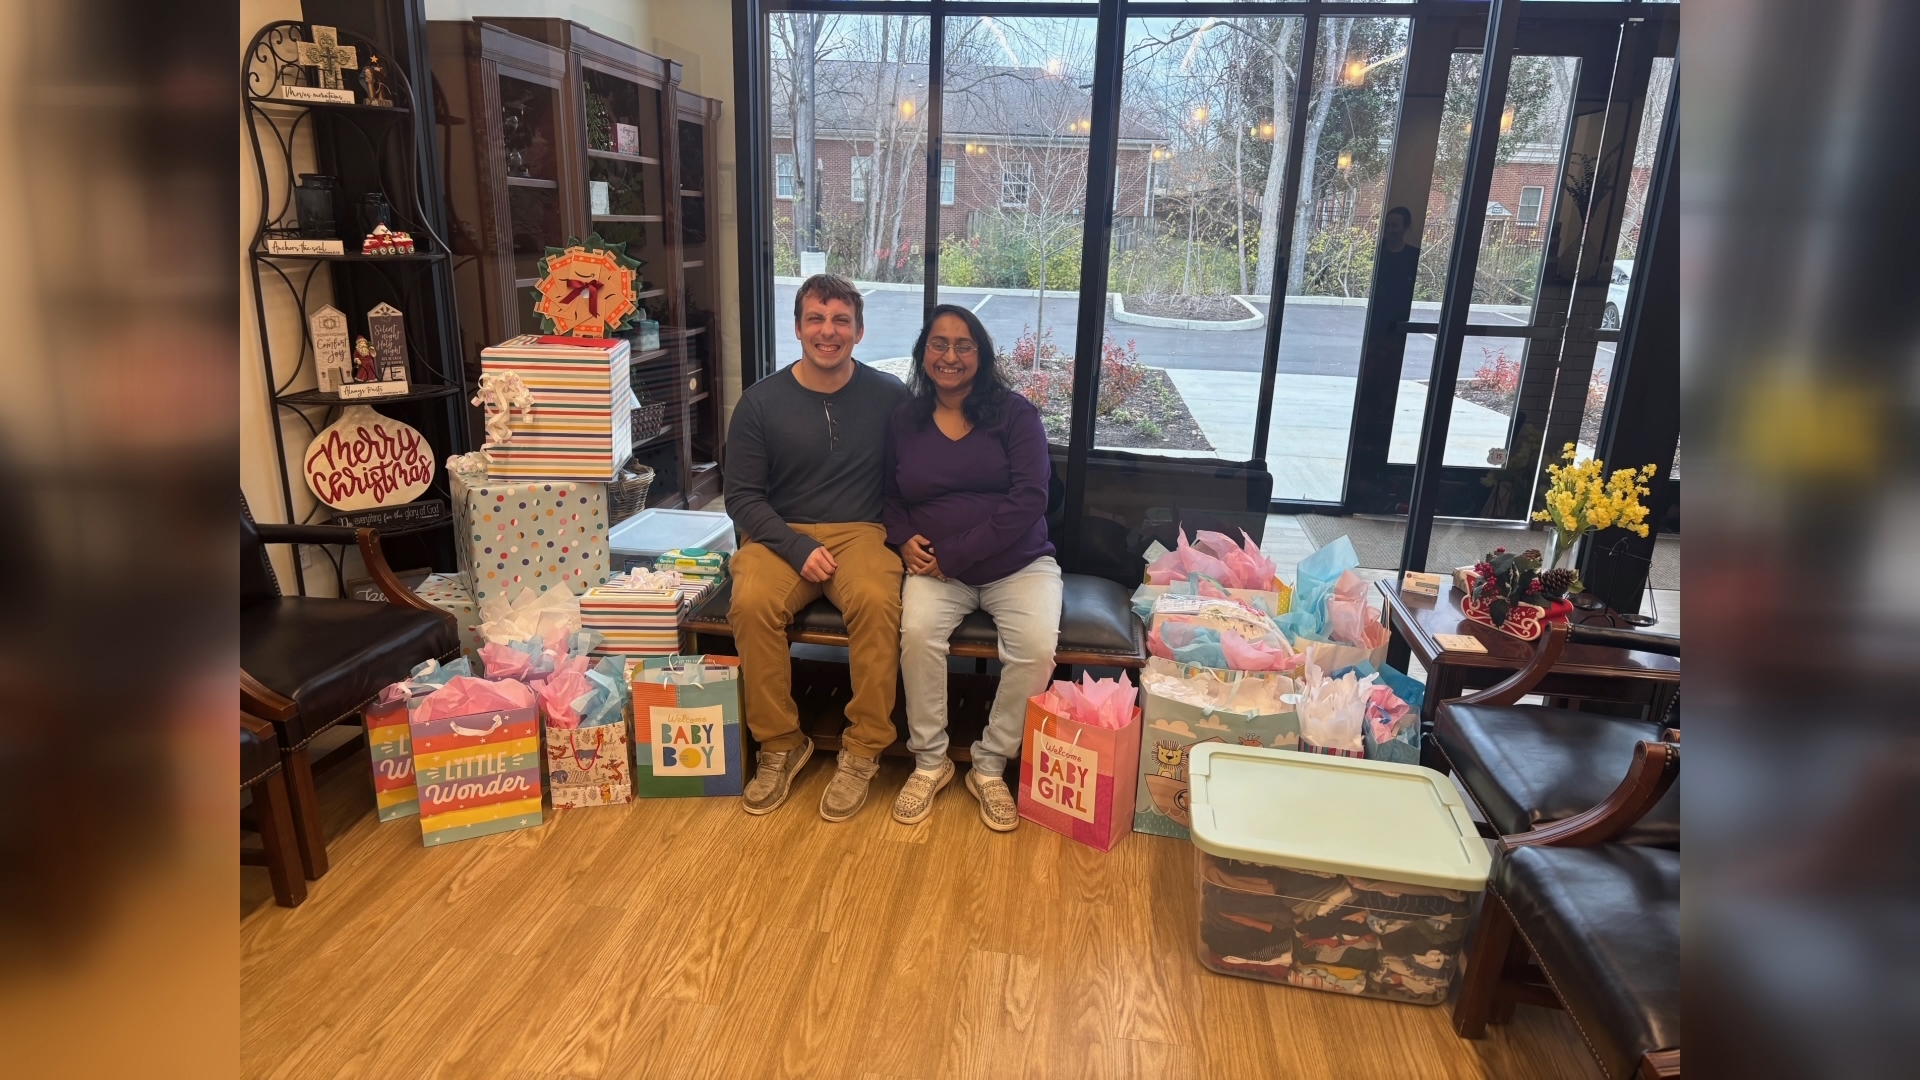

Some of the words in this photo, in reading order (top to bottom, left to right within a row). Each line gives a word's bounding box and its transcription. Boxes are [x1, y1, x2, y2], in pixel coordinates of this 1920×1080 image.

[285, 86, 311, 98] Moves
[272, 241, 299, 254] Anchors
[298, 241, 311, 253] the
[374, 323, 398, 336] Silent
[381, 330, 402, 341] night
[317, 337, 348, 350] Comfort
[376, 339, 394, 350] Holy
[327, 349, 346, 363] Joy
[383, 345, 404, 356] night
[344, 386, 365, 397] Always
[312, 454, 432, 504] Christmas
[354, 512, 381, 526] everything
[383, 512, 393, 523] for
[393, 509, 403, 519] the
[404, 507, 419, 520] glory
[419, 505, 426, 516] of
[426, 503, 440, 515] God
[667, 713, 707, 724] Welcome
[661, 723, 714, 745] BABY
[662, 746, 715, 769] BOY
[1045, 741, 1082, 763] Welcome
[1040, 750, 1089, 789] BABY
[425, 774, 530, 805] Wonder
[1037, 776, 1087, 814] GIRL
